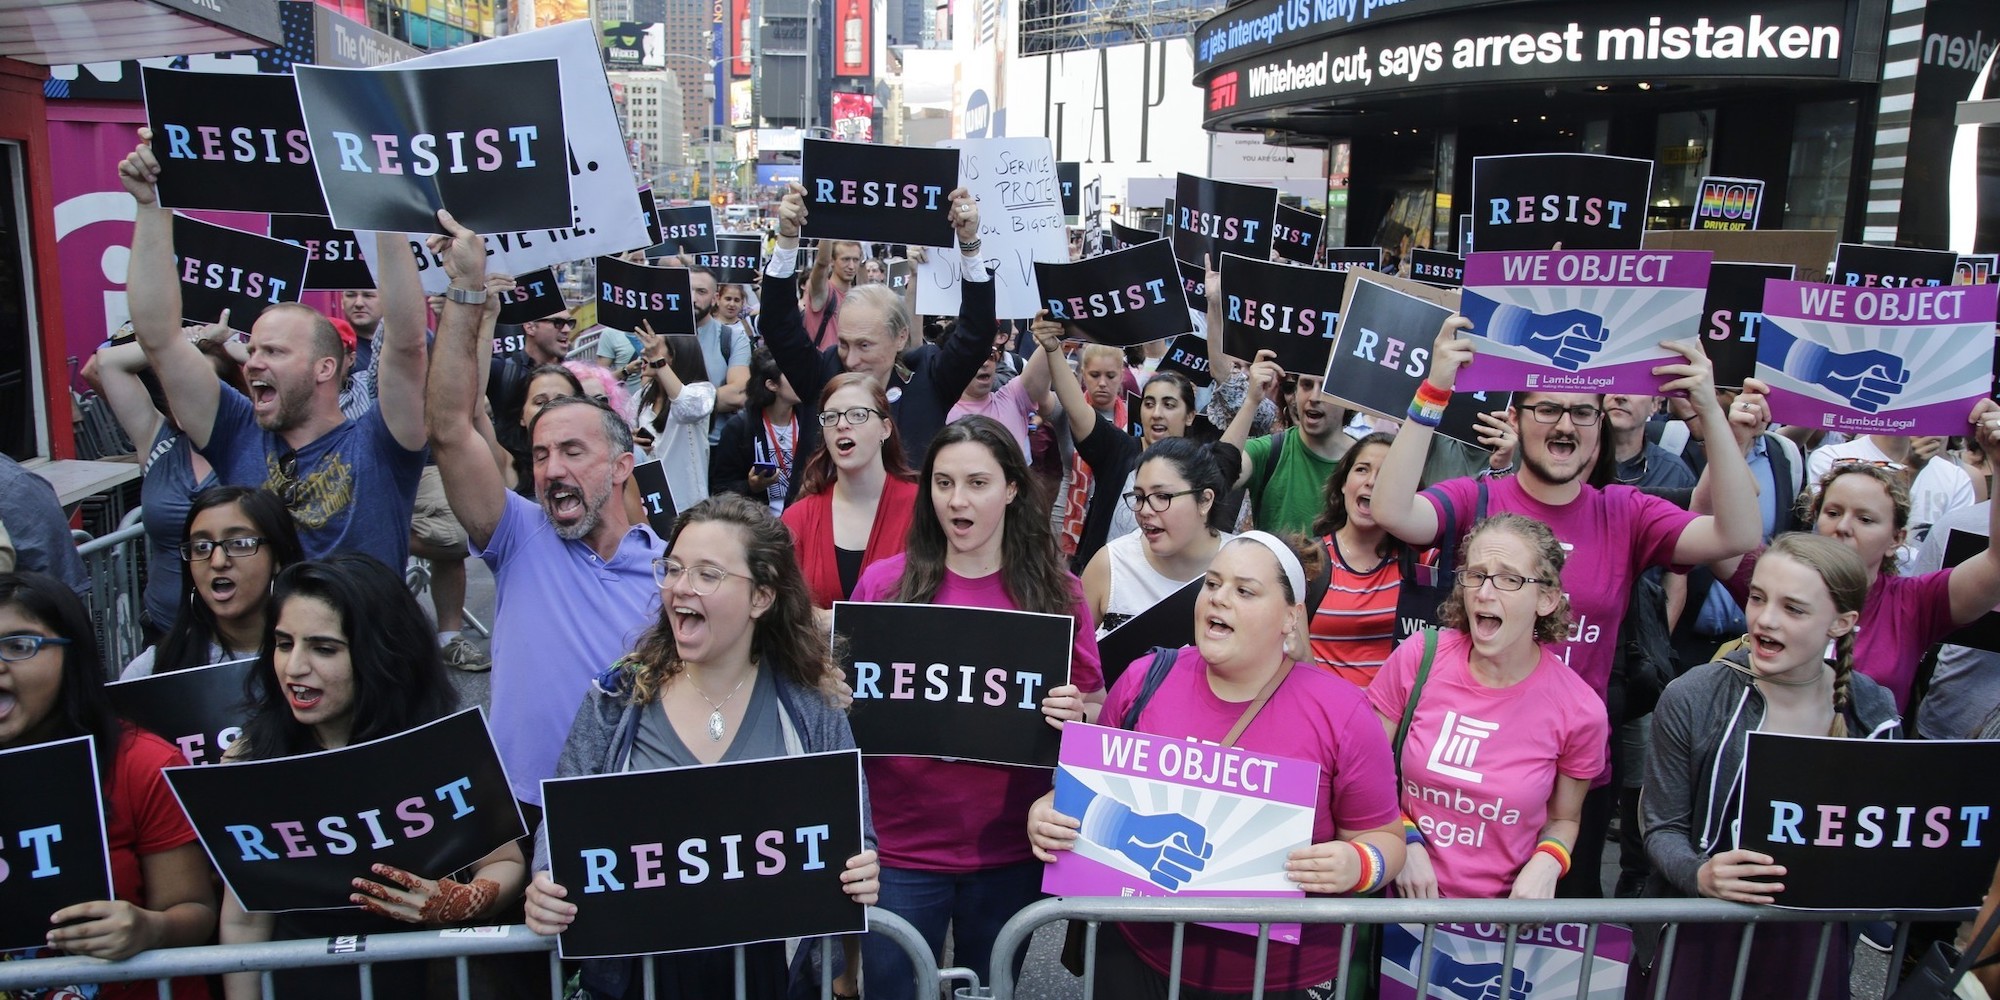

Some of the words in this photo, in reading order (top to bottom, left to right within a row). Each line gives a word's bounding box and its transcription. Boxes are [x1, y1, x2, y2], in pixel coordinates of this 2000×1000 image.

[335, 23, 357, 60] The
[358, 34, 393, 67] Official
[1208, 29, 1227, 63] jets
[1228, 5, 1283, 44] intercept
[1286, 0, 1310, 31] US
[1313, 0, 1358, 24] Navy
[1249, 51, 1328, 98] Whitehead
[1332, 46, 1372, 86] cut,
[1378, 41, 1443, 82] says
[1452, 22, 1583, 69] arrest
[1596, 14, 1840, 62] mistaken
[164, 124, 311, 165] RESIS
[332, 125, 538, 177] RESIST
[995, 151, 1050, 175] SERVICE
[815, 178, 941, 210] RESIST
[1700, 183, 1758, 220] NO!
[1180, 206, 1259, 244] RESIST
[1489, 195, 1627, 230] RESIST
[1703, 220, 1729, 230] DRIVE
[1729, 222, 1747, 231] OUT
[661, 223, 707, 240] ESIST
[1274, 223, 1312, 246] SIST
[175, 254, 287, 304] ESIST
[701, 255, 756, 269] RESIST
[1415, 263, 1463, 280] RESIST
[1502, 255, 1549, 282] WE
[1556, 255, 1673, 283] OBJECT
[501, 281, 545, 305] IST
[602, 282, 680, 312] RESIST
[1047, 278, 1166, 320] RESIST
[1800, 287, 1846, 318] WE
[1854, 290, 1965, 322] OBJECT
[1228, 295, 1340, 339] RESIST
[492, 334, 525, 354] ESI
[1171, 348, 1210, 372] RESI
[1352, 327, 1429, 378] RES
[1543, 375, 1585, 385] Lambda
[1587, 376, 1615, 388] Legal
[1839, 415, 1885, 427] Lambda
[1887, 418, 1916, 430] Legal
[852, 661, 1042, 710] RESIST
[1101, 733, 1151, 772] WE
[1158, 743, 1279, 793] OBJECT
[225, 776, 476, 862] RESIST
[1411, 806, 1486, 848] egal
[1766, 800, 1990, 848] RESIST
[580, 824, 830, 894] RESIST
[1474, 922, 1589, 949] OECT
